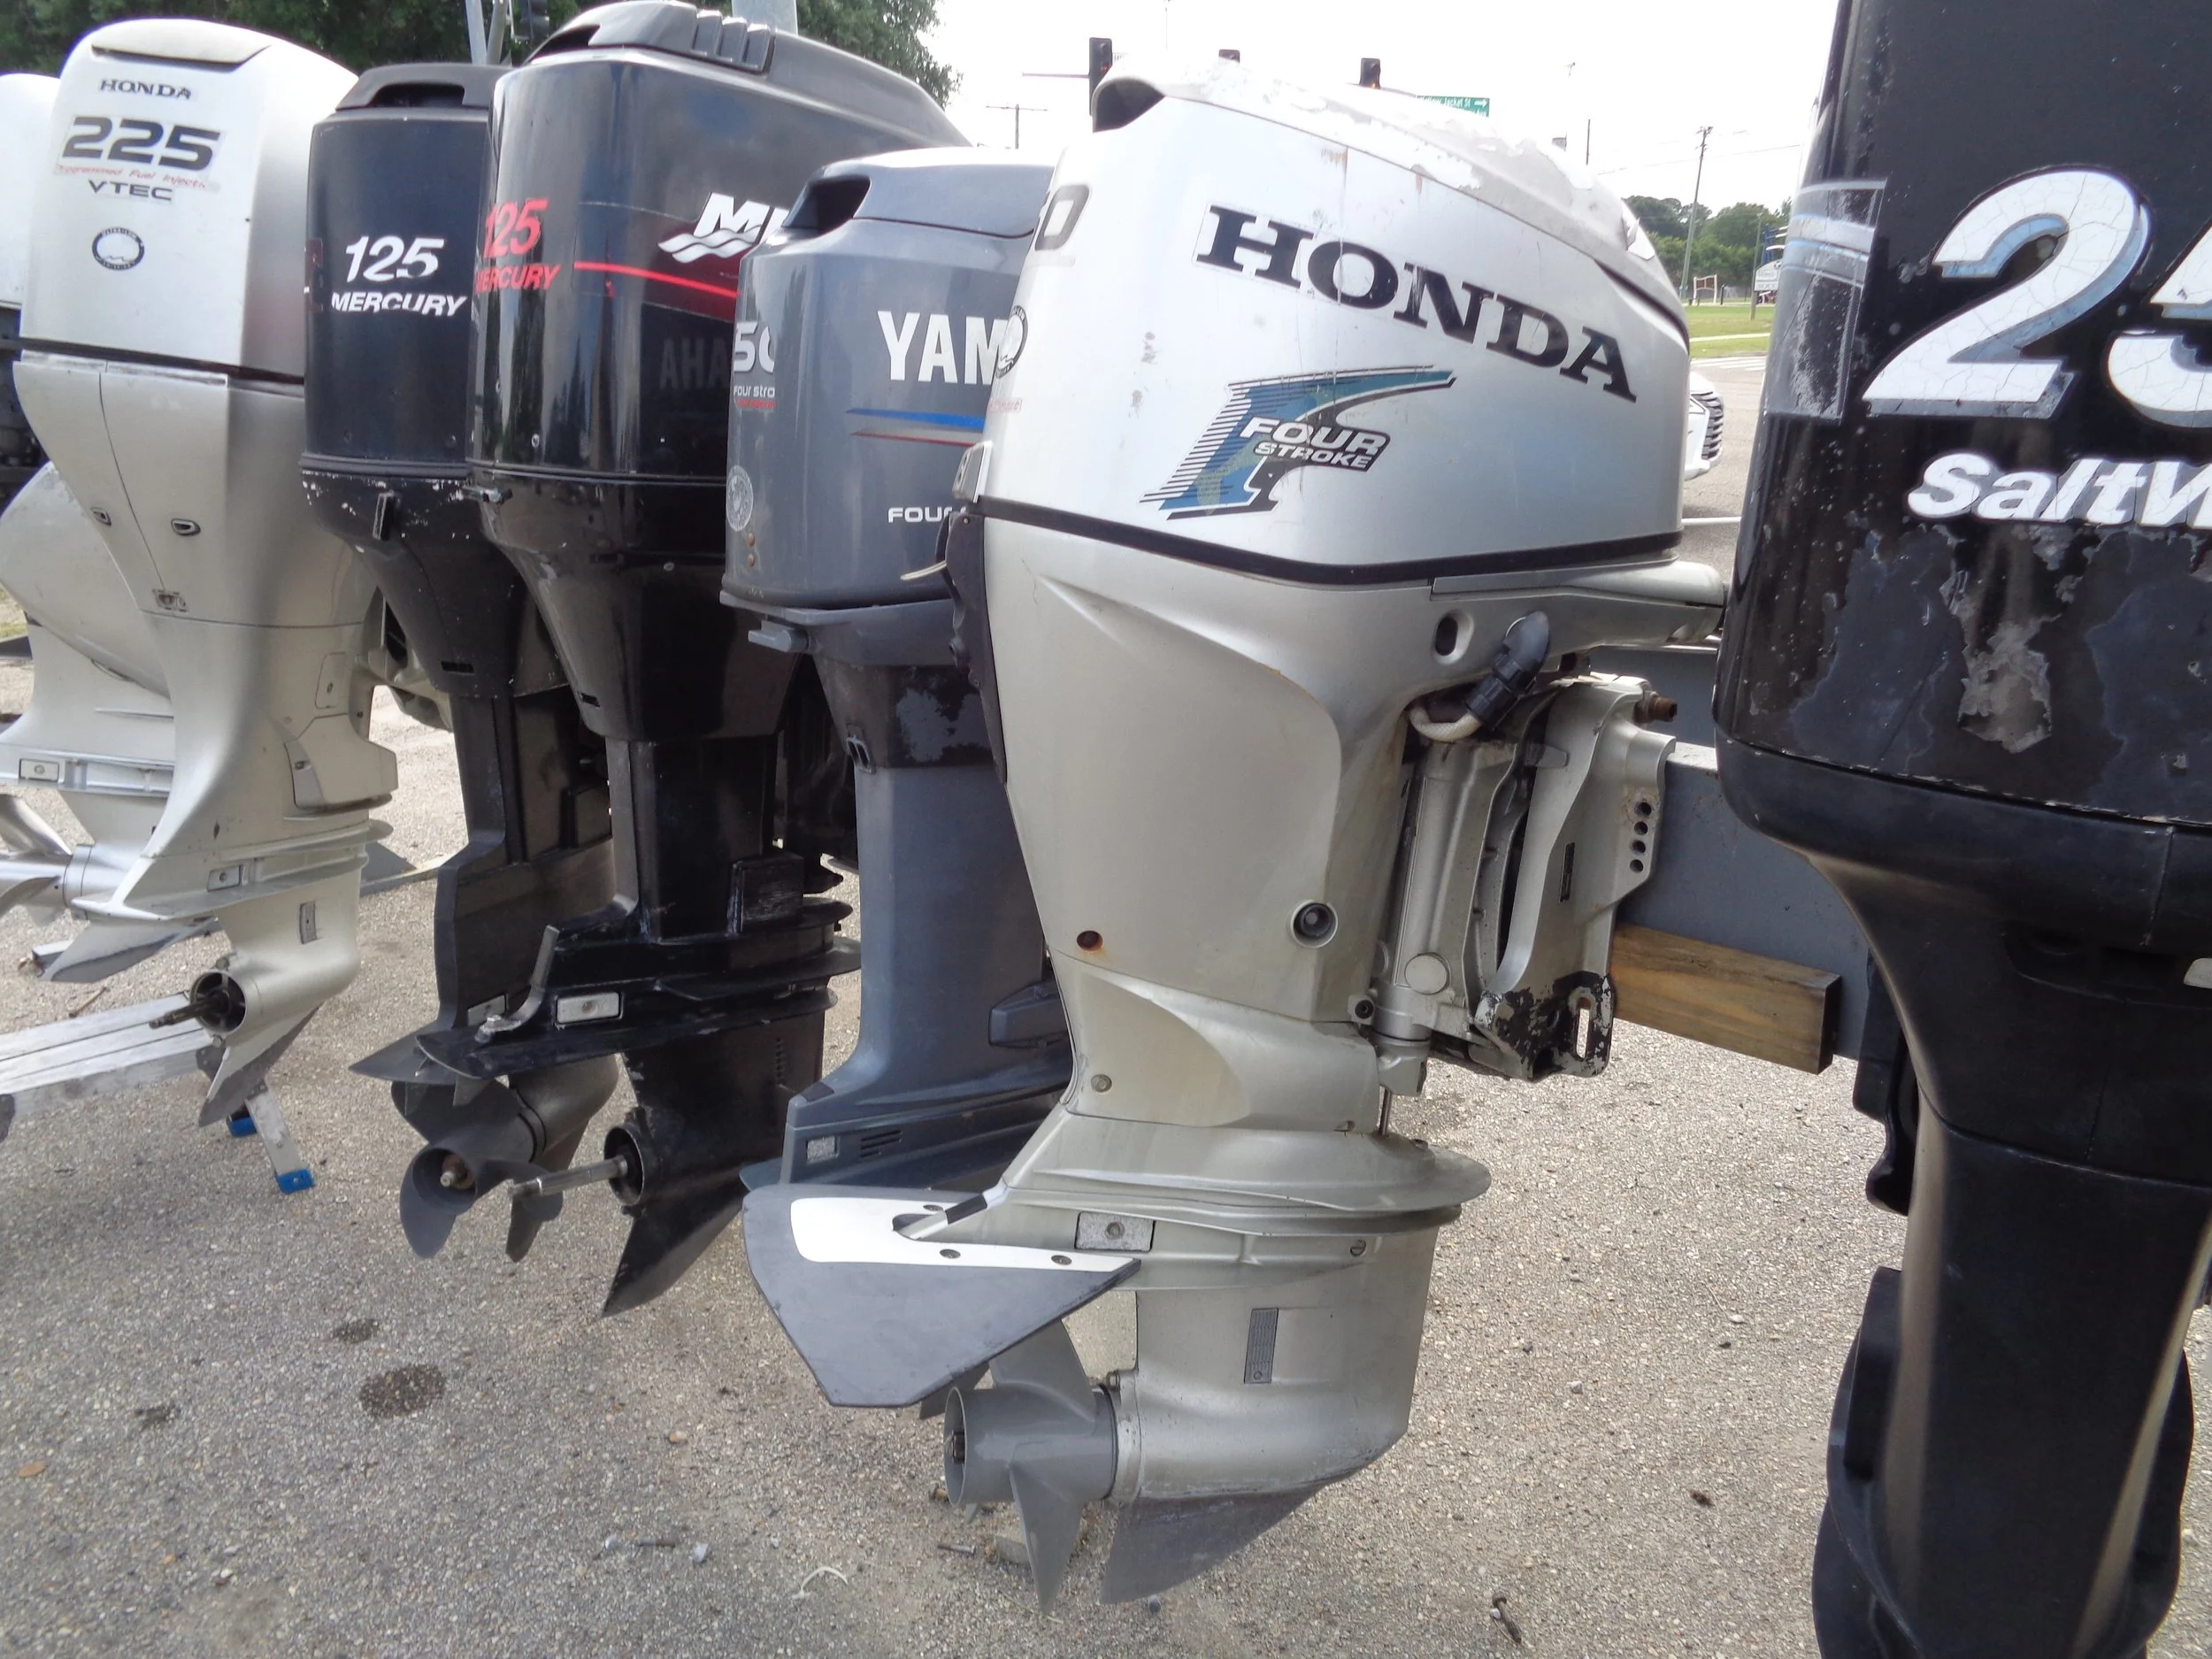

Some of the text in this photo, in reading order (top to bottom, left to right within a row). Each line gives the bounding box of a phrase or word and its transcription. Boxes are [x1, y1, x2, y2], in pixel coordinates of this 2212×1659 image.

[100, 79, 192, 99] HONDA
[63, 117, 220, 172] 225
[88, 180, 173, 201] VTEC
[129, 169, 157, 180] Fuel
[483, 198, 549, 258] 125
[345, 235, 445, 283] 125
[331, 291, 467, 318] MERCURY
[1196, 204, 1637, 403] HONDA
[877, 310, 1010, 386] YAM
[1240, 417, 1386, 456] FOUR
[1255, 442, 1372, 468] STROKE
